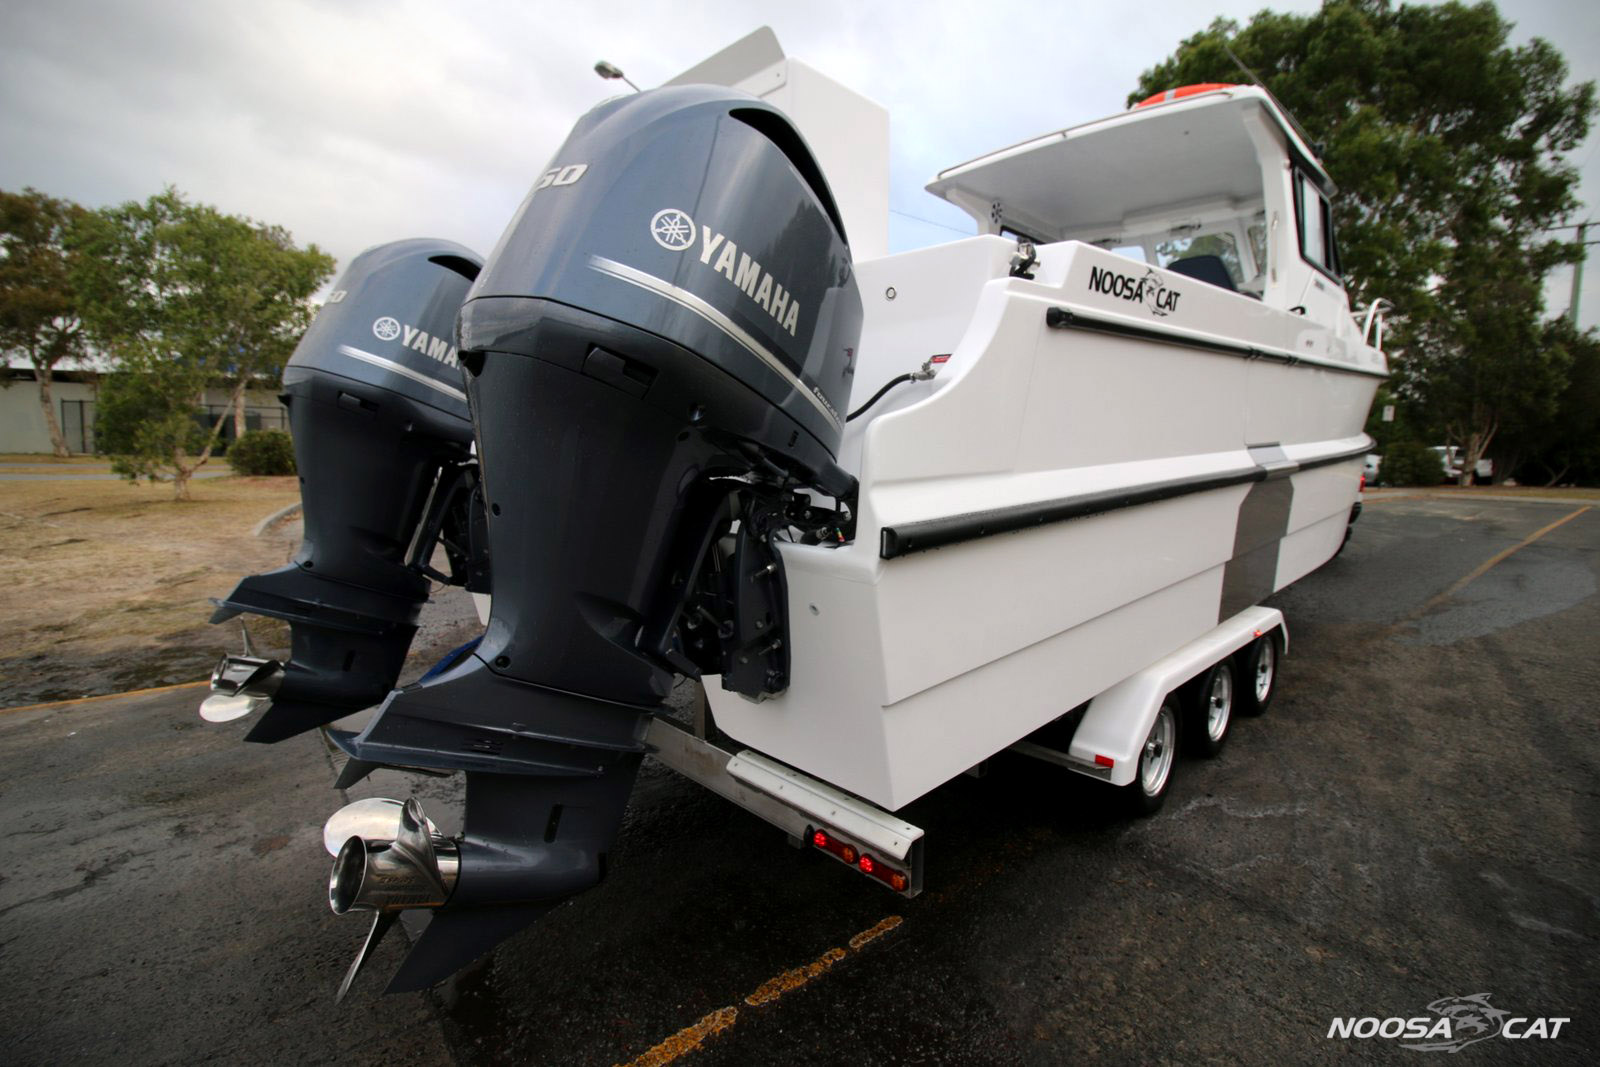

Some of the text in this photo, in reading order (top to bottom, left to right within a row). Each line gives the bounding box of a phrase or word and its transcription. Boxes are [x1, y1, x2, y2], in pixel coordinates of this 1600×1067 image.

[700, 225, 800, 337] YAMAHA
[1088, 266, 1181, 312] NOOSA CAT
[402, 324, 460, 371] YAMA
